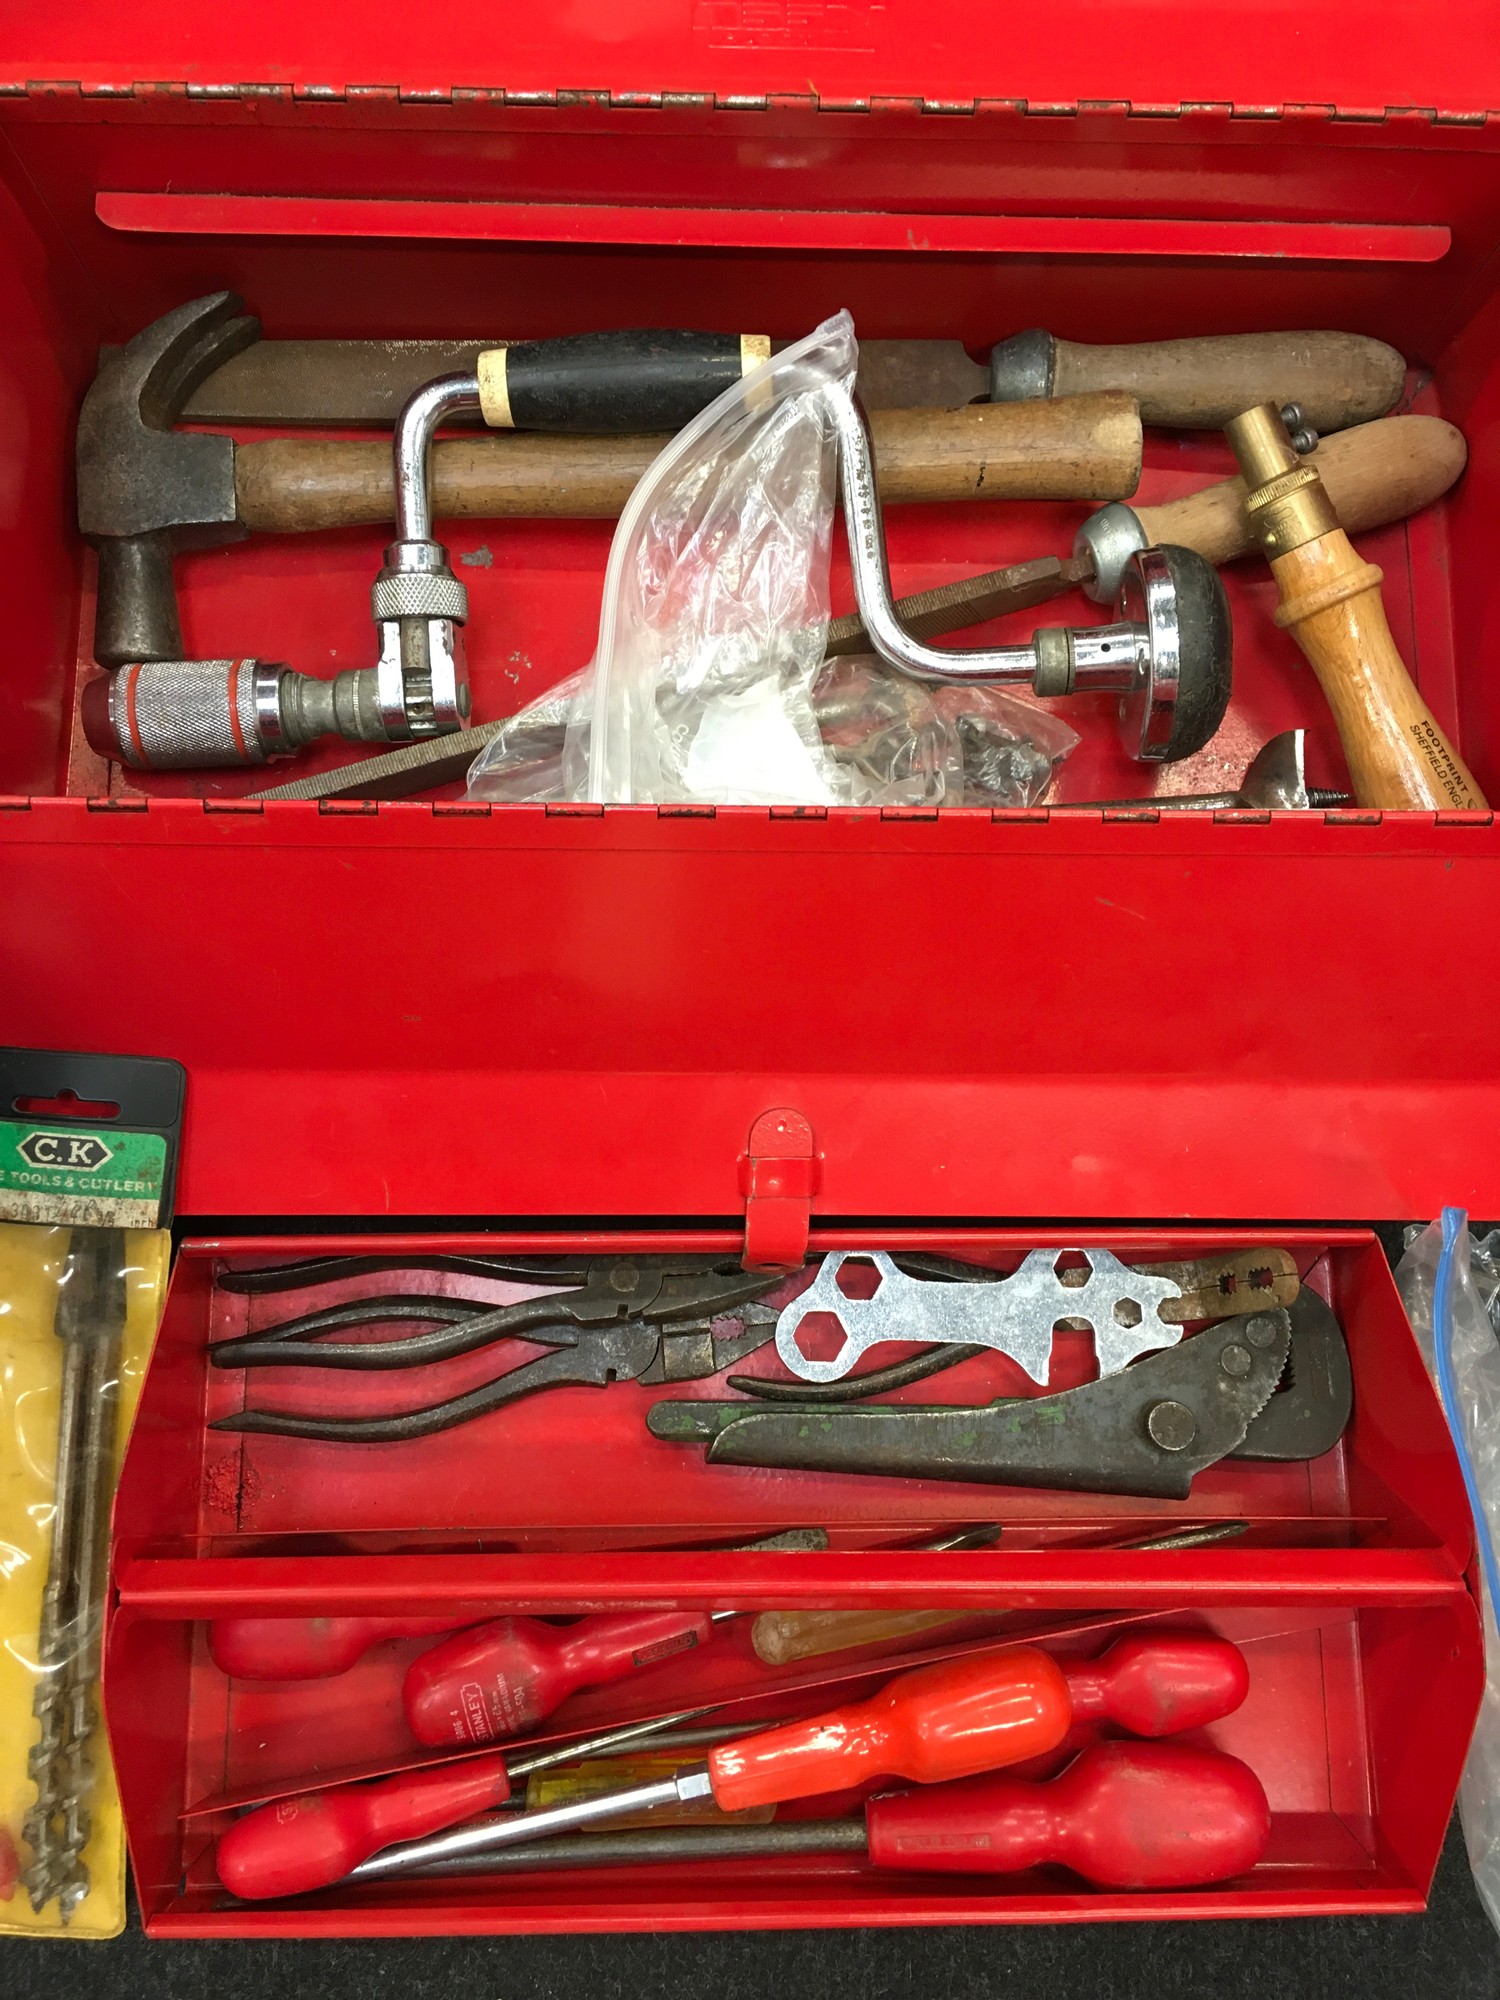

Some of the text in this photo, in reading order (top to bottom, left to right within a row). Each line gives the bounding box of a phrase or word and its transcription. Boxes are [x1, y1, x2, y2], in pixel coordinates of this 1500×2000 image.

[1409, 724, 1448, 779] SHEFFIELD
[1421, 720, 1469, 793] FOOTPRINT
[34, 1138, 94, 1164] C.K
[11, 1171, 62, 1187] TOOLS
[64, 1177, 75, 1188] &
[79, 1178, 158, 1193] CUTLERY
[466, 1692, 489, 1740] STANLEY
